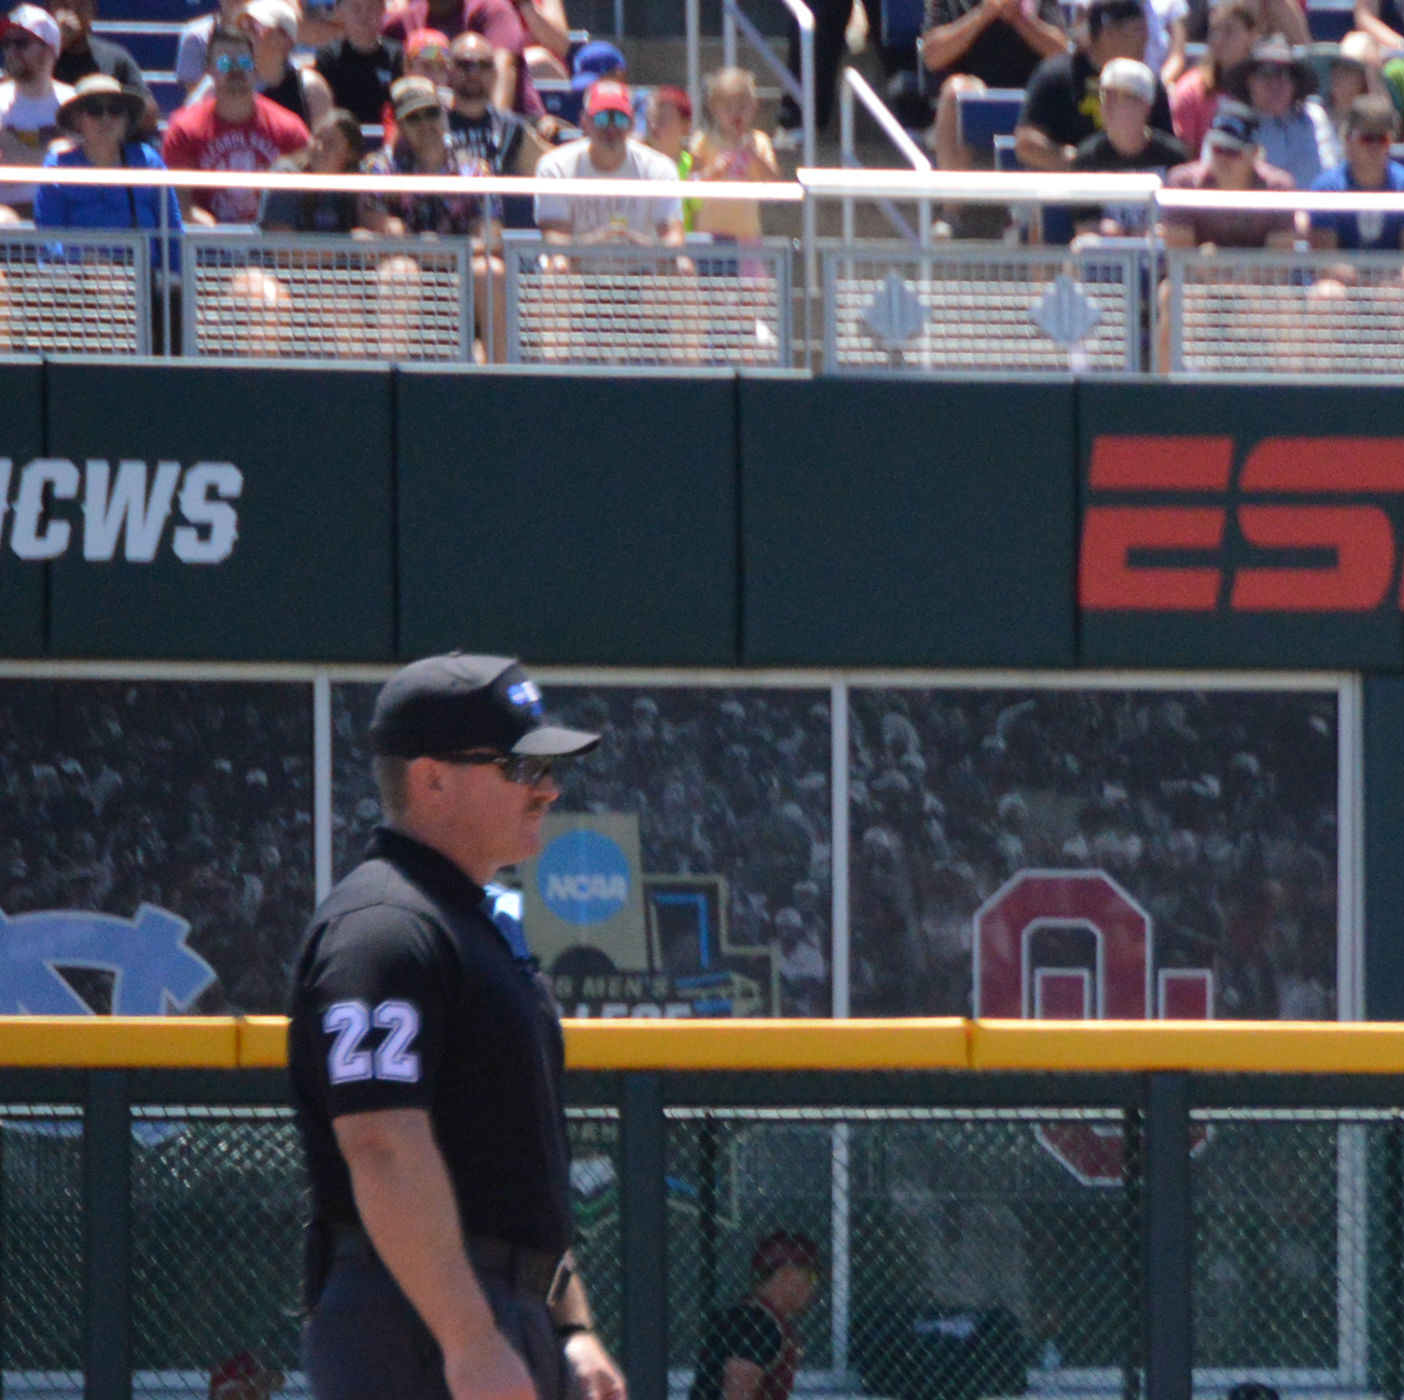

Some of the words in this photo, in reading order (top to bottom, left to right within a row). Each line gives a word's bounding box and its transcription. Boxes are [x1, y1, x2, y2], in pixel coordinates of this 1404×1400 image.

[0, 456, 244, 564] CWS
[546, 872, 629, 900] NCAA
[323, 1000, 419, 1084] 22
